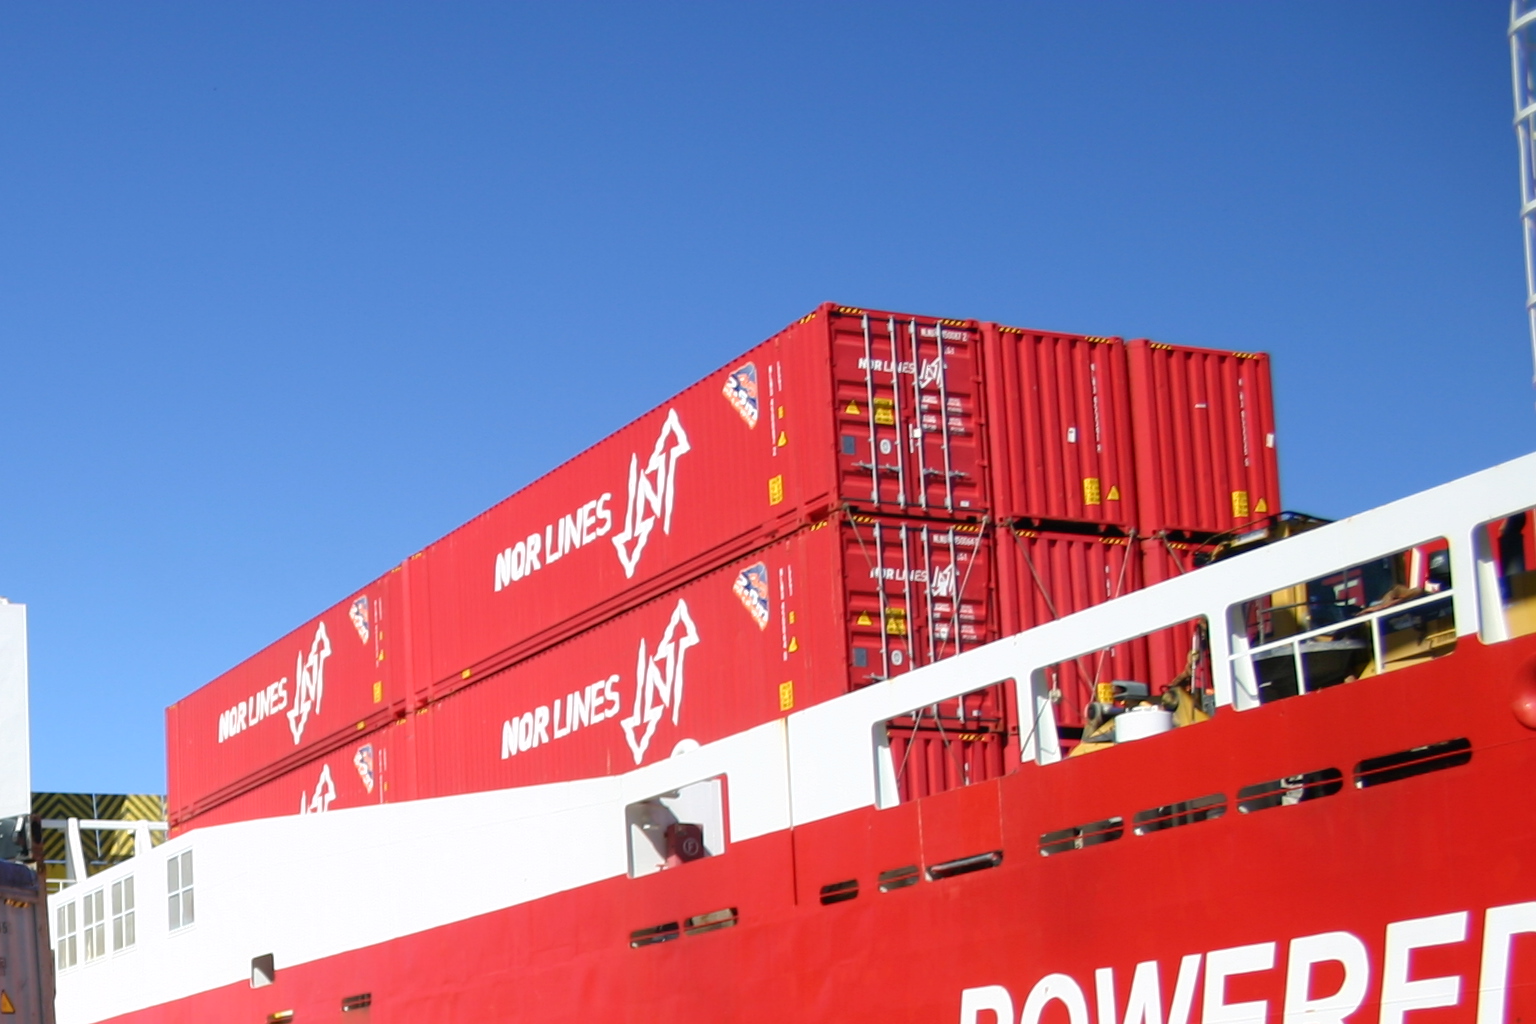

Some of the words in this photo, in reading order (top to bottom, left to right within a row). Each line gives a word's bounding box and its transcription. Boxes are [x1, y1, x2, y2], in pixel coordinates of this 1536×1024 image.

[494, 533, 542, 592] NOR
[545, 492, 612, 565] LINES
[218, 701, 247, 744] NOR
[248, 677, 288, 727] LINES
[501, 705, 550, 760] NOR
[553, 674, 620, 740] LINES
